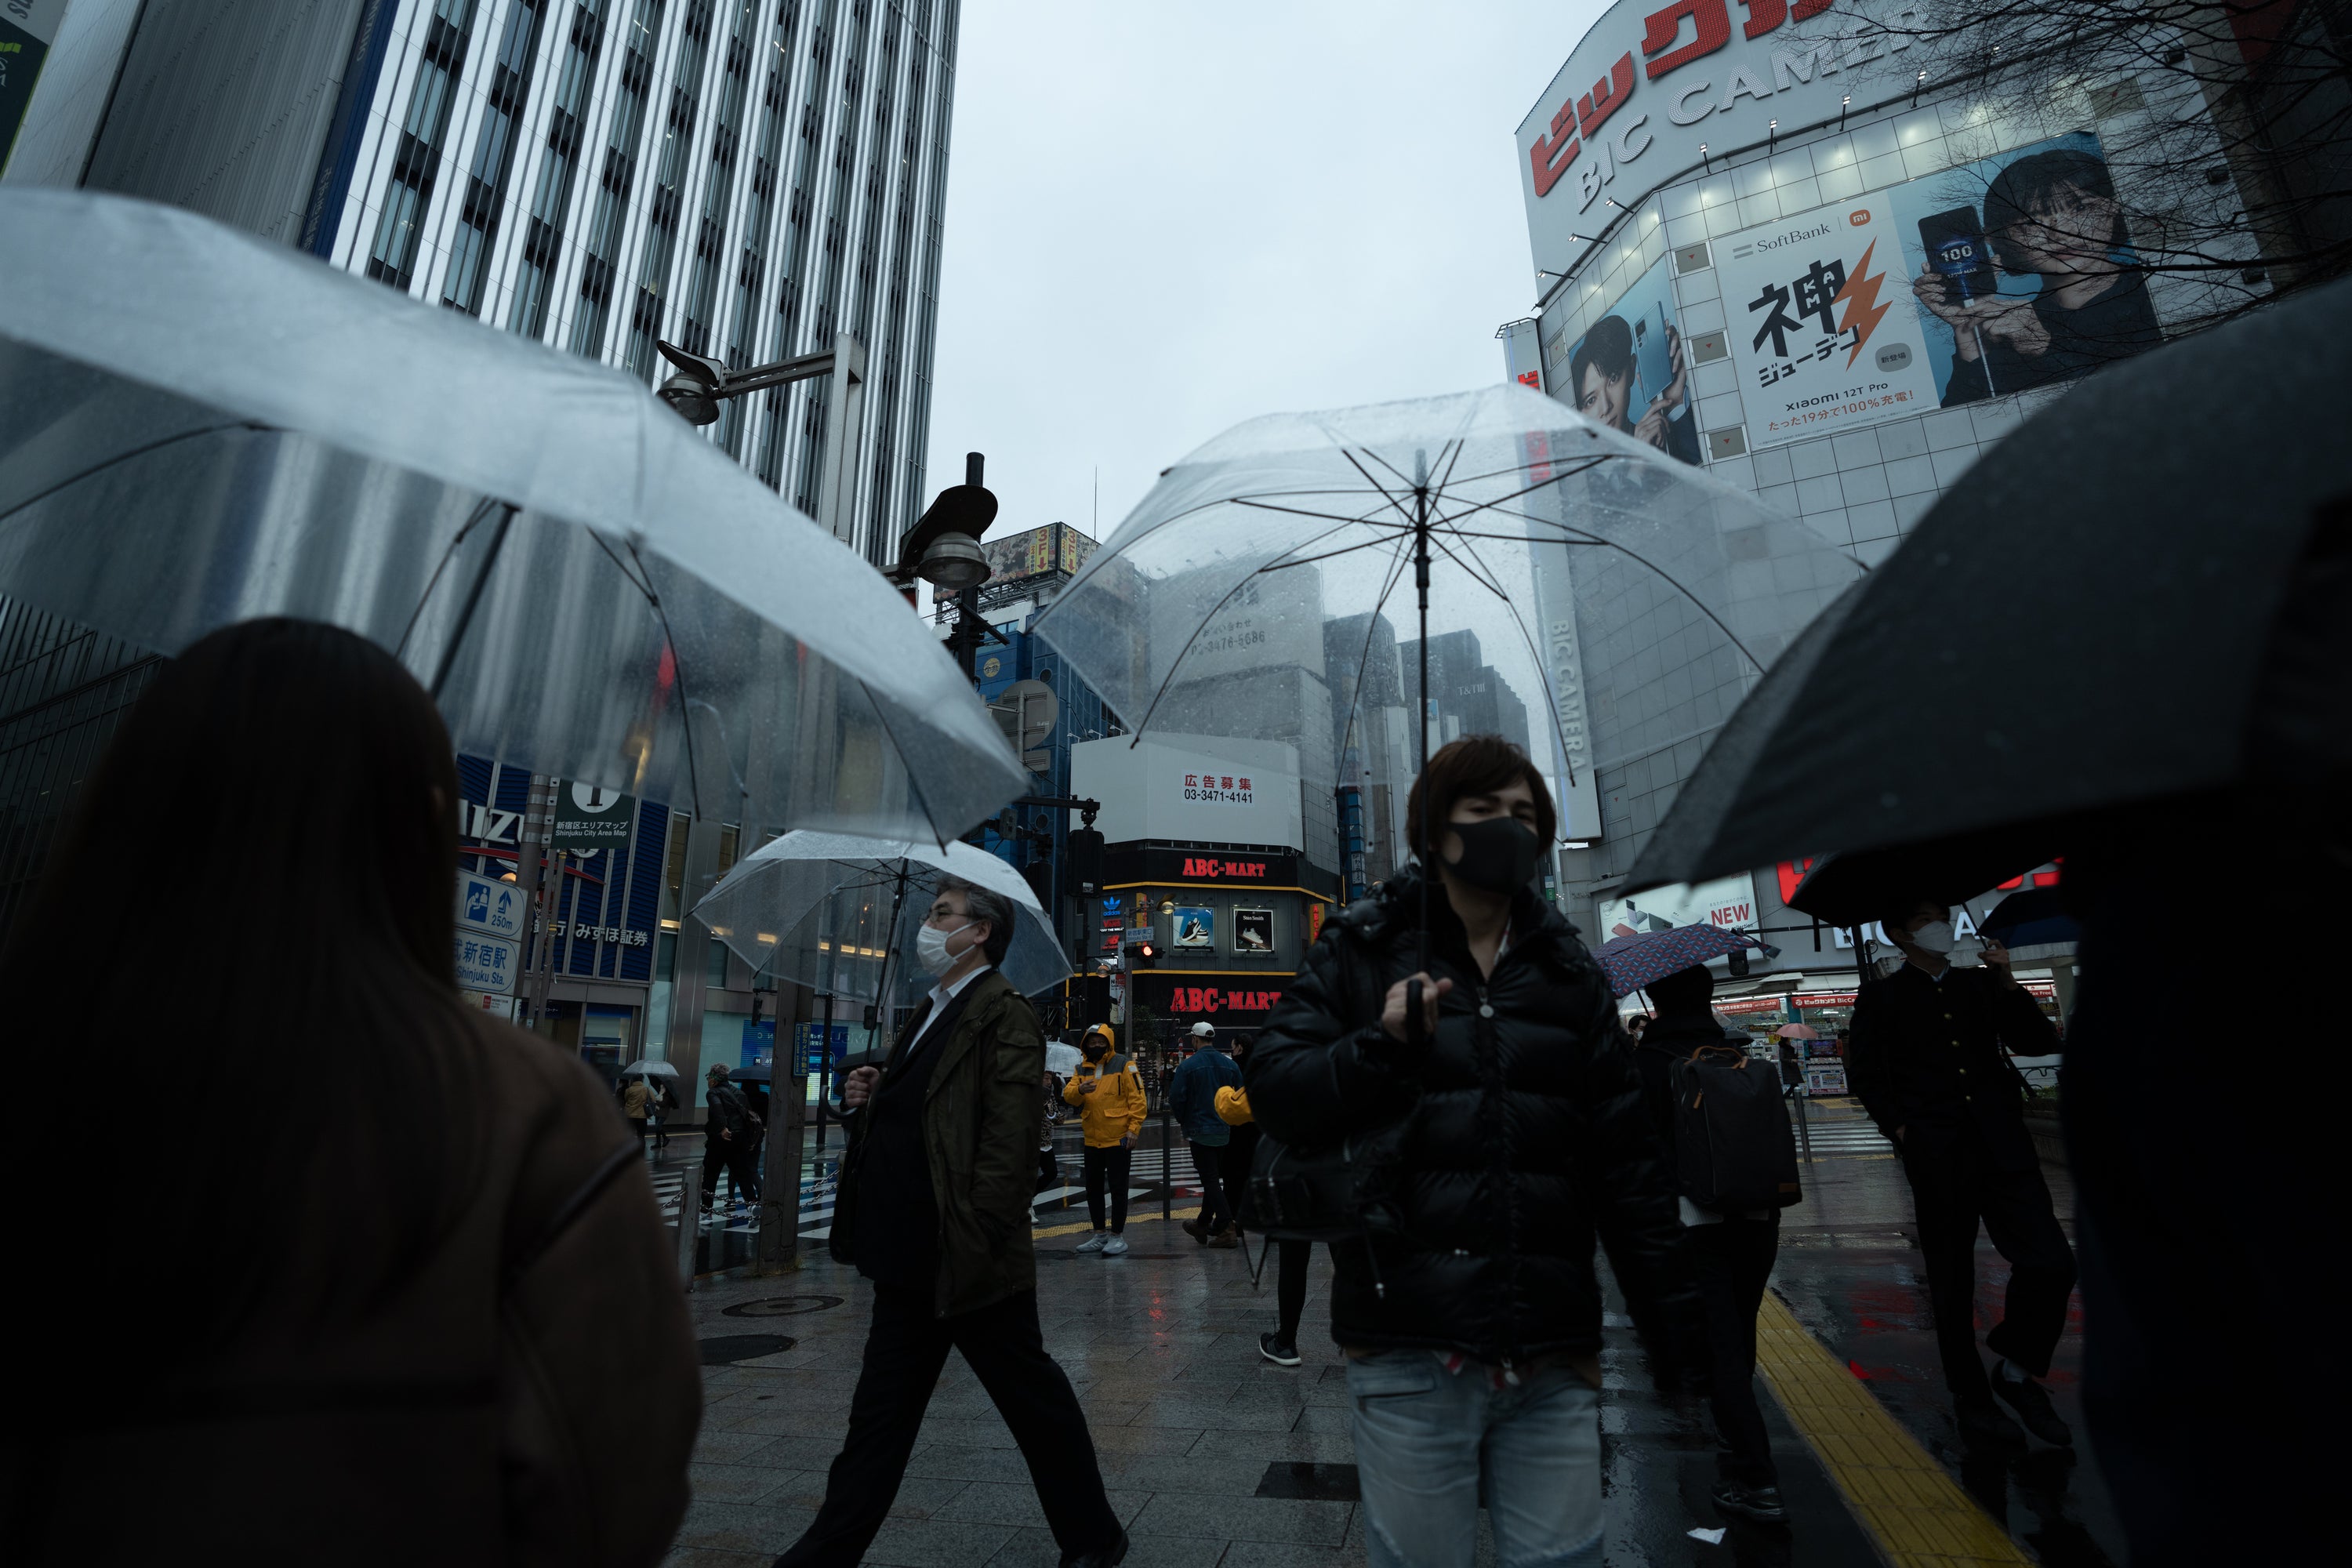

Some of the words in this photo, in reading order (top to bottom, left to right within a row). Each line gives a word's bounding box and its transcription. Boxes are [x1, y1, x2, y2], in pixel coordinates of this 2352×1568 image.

[1574, 114, 1652, 214] BIC
[1757, 223, 1831, 253] SoftBank
[1941, 245, 1973, 263] 100
[1748, 259, 1847, 358] 神
[1881, 351, 1907, 364] 新登場
[1843, 387, 1864, 399] 12T
[1869, 382, 1889, 393] Pro
[1038, 528, 1047, 556] 3F
[1068, 530, 1076, 556] 3F
[1552, 620, 1573, 659] BIC
[1556, 666, 1586, 771] CAMERA
[1185, 774, 1251, 790] 広告募集
[1185, 789, 1252, 804] 03-3471-4141
[557, 820, 628, 830] 新宿区エリアマップ
[1182, 858, 1266, 877] ABC-MART
[492, 914, 513, 930] 250m
[1711, 902, 1749, 926] NEW
[575, 923, 648, 947] みずほ証券
[491, 972, 505, 985] Sta.
